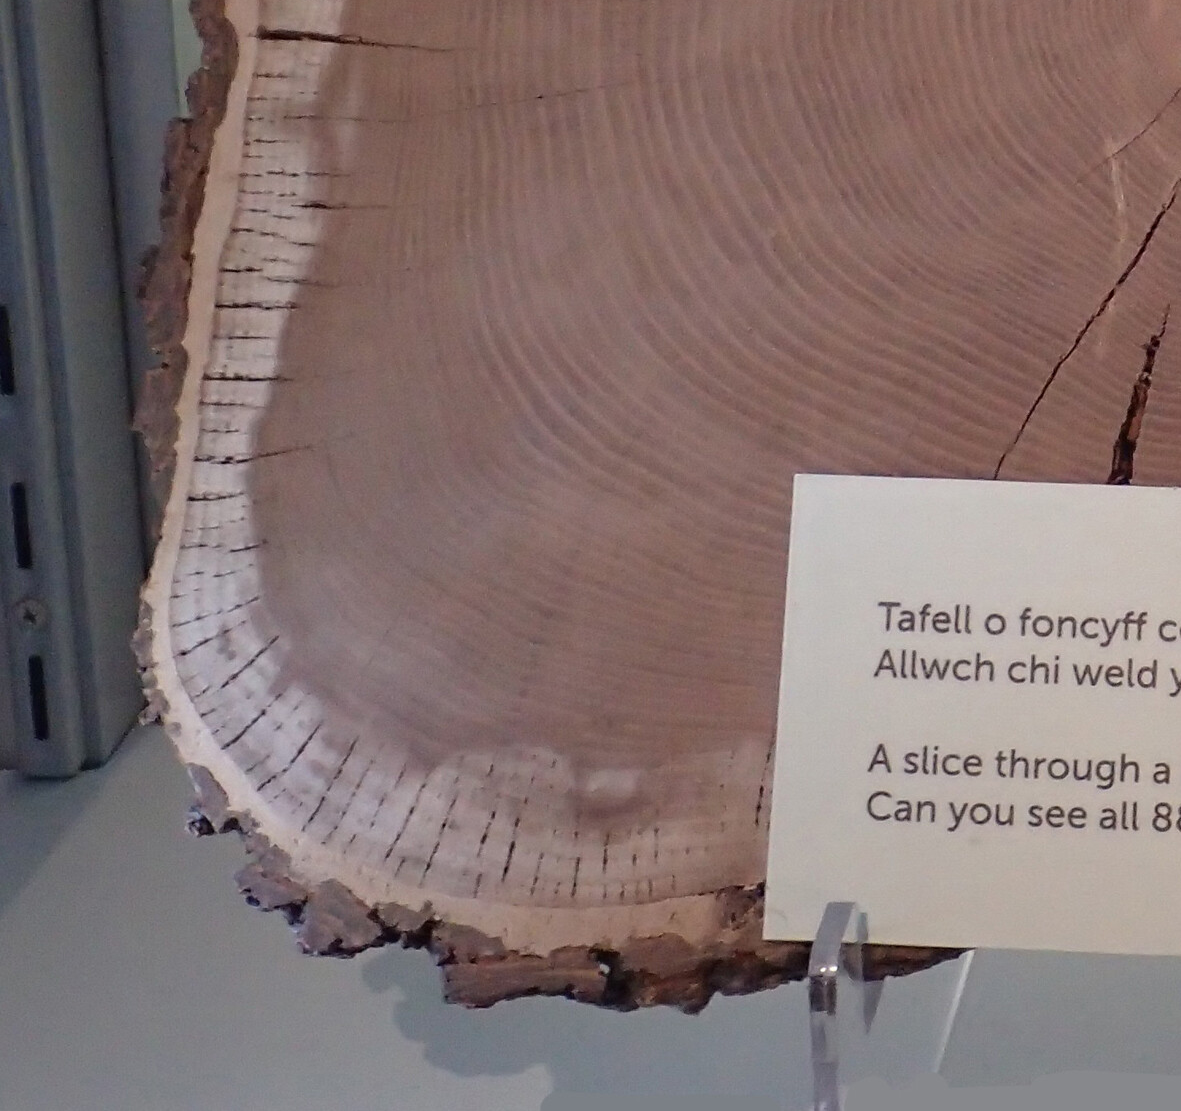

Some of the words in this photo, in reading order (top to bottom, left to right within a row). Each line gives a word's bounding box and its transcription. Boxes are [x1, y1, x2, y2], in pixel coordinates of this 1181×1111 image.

[878, 602, 971, 635] Tafell
[984, 614, 1006, 635] o
[1019, 607, 1148, 647] foncyff
[874, 649, 994, 682] Allwch
[1008, 654, 1059, 684] chi
[1073, 658, 1157, 688] weld
[867, 743, 892, 773] A
[904, 745, 982, 776] slice
[995, 749, 1139, 790] through
[1153, 763, 1170, 784] a
[867, 791, 936, 823] Can
[947, 802, 1014, 832] you
[1028, 805, 1087, 829] see
[1099, 801, 1139, 831] all
